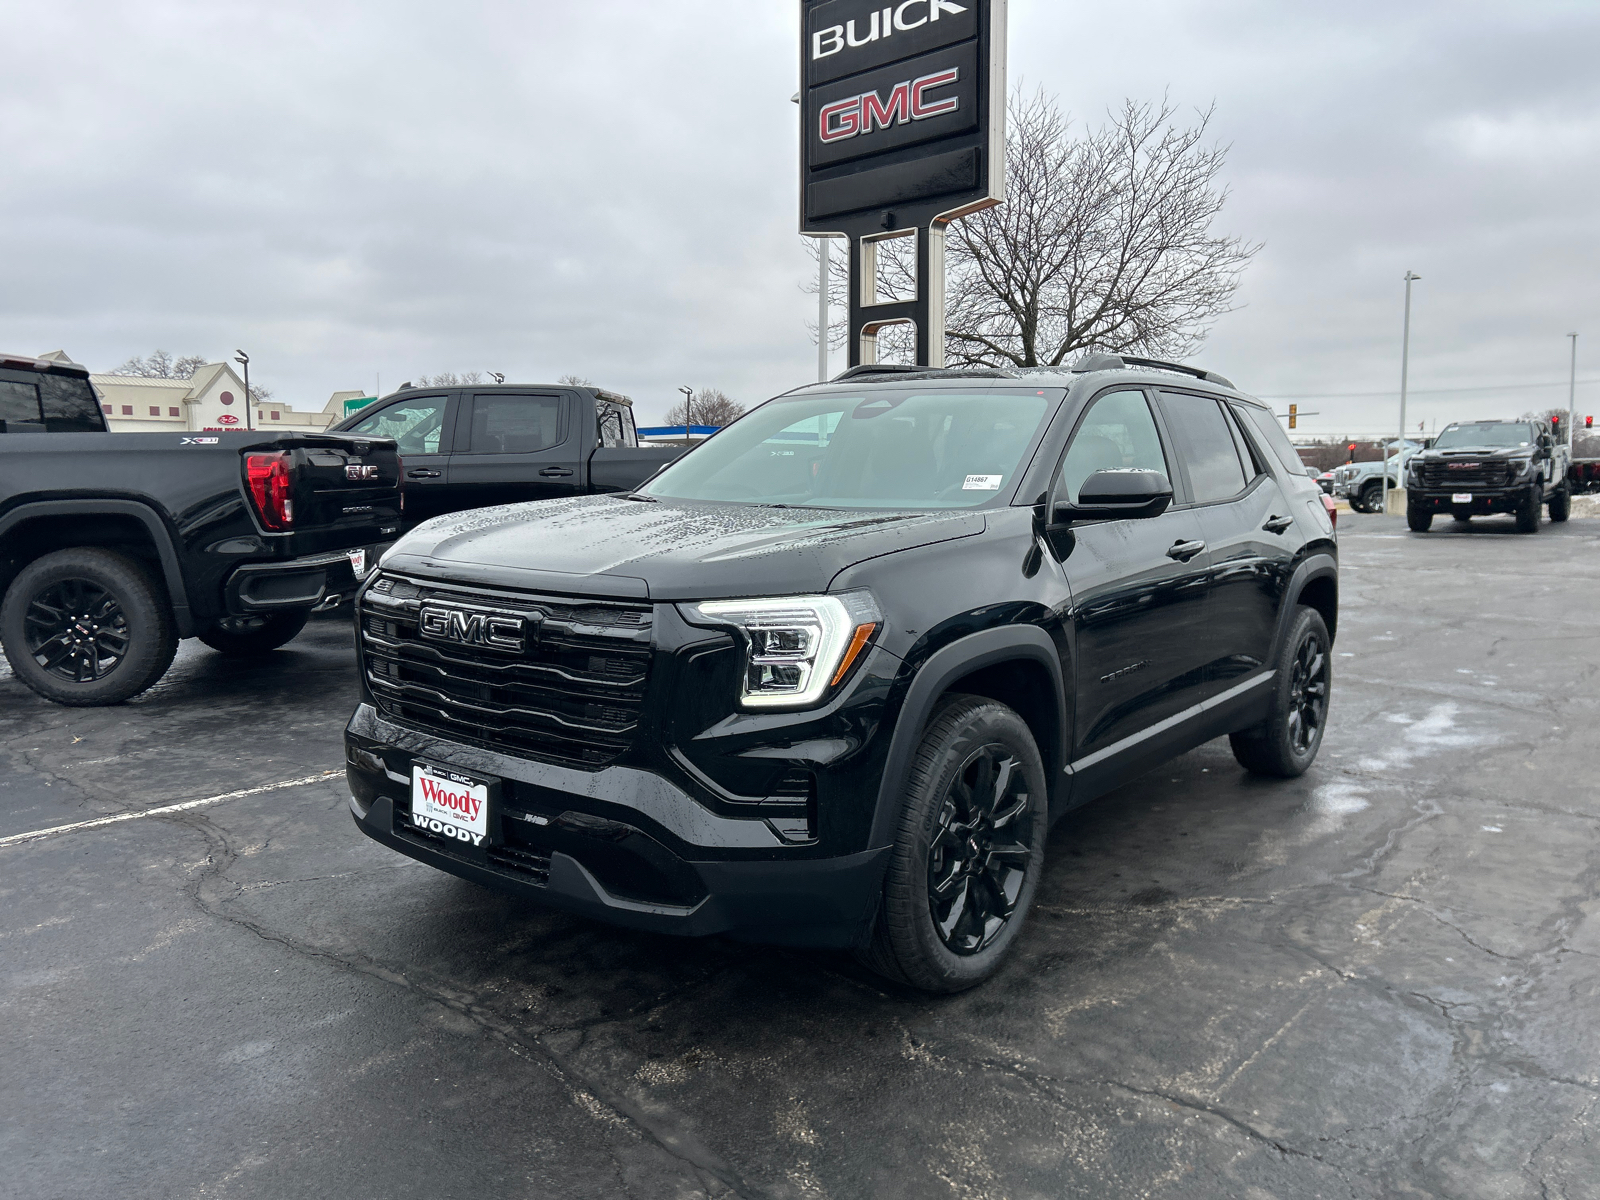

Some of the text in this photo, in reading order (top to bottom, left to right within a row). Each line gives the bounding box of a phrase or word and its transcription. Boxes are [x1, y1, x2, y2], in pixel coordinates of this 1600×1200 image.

[813, 0, 968, 60] BUICK
[820, 67, 959, 144] GMC
[345, 465, 378, 480] GMC
[420, 606, 525, 654] GMC
[450, 773, 470, 785] GMC
[419, 777, 482, 821] Woody
[453, 812, 469, 822] GMC
[412, 814, 484, 846] WOODY
